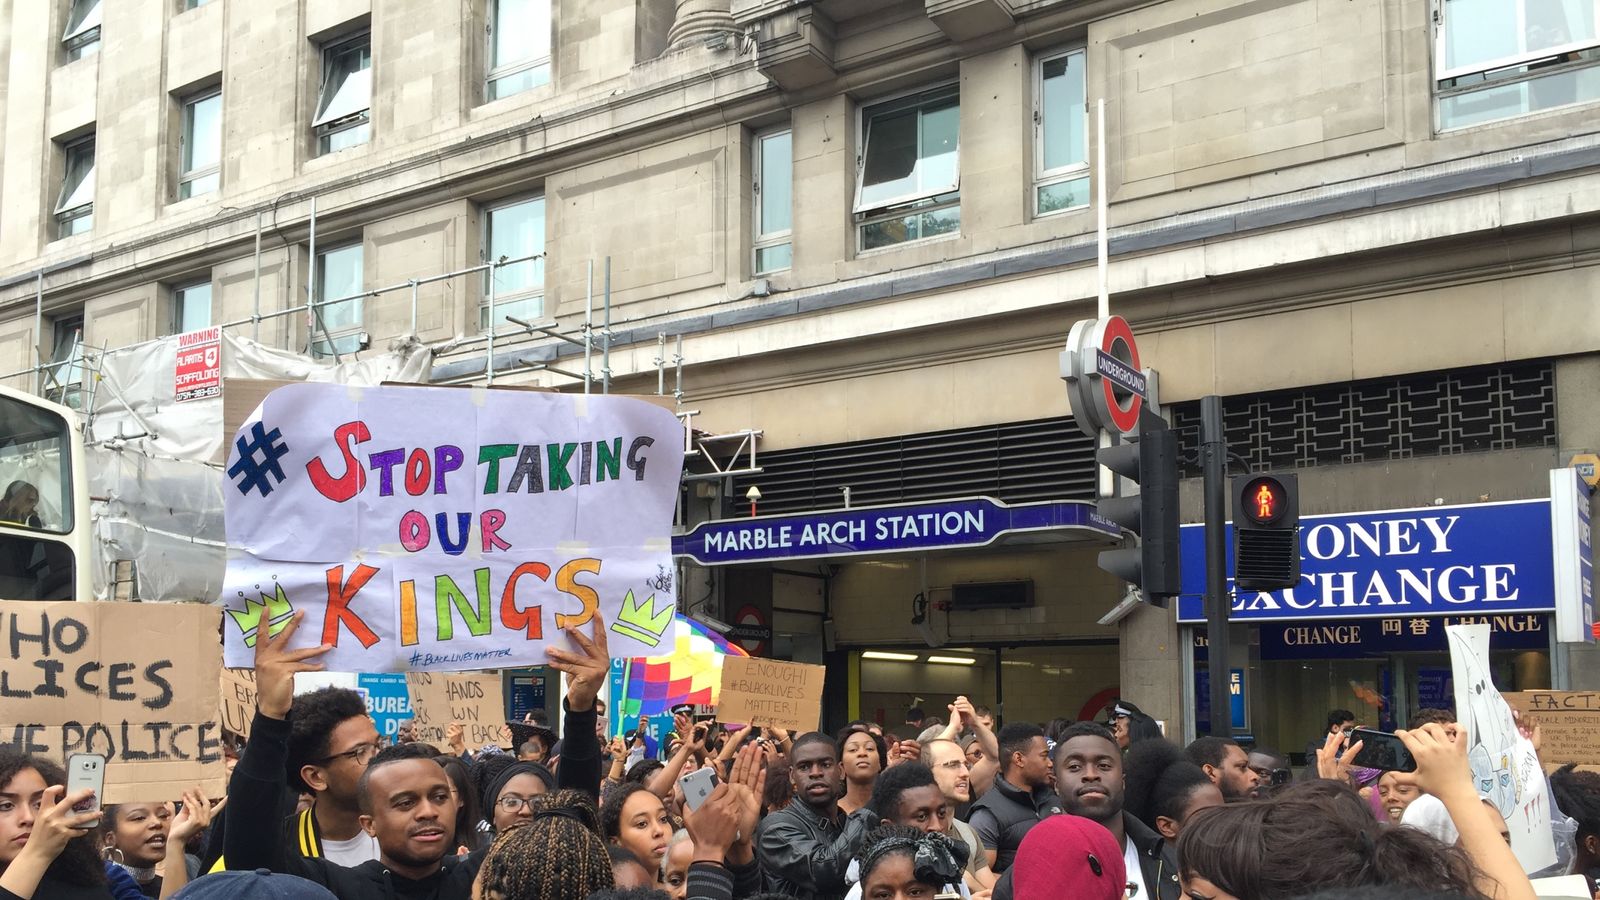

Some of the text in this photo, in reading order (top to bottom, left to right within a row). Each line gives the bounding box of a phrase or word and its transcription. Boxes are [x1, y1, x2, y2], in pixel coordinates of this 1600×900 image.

[179, 328, 219, 347] WARNING
[177, 351, 215, 367] ALARMS 4
[176, 368, 219, 385] SCAFFOLDING
[1097, 355, 1145, 392] UNDERGROUND
[478, 436, 654, 495] TAKING
[400, 509, 512, 555] OUR
[704, 510, 985, 554] MARBLE ARCH STATION
[1296, 515, 1460, 562] ONEY
[321, 558, 602, 649] KINGS
[0, 609, 90, 660] HO
[1284, 625, 1361, 646] CHANGE
[745, 663, 807, 685] ENOUGH!
[235, 682, 258, 707] BR
[731, 679, 805, 700] #BLACKLIVES
[1529, 694, 1600, 709] FACT
[62, 719, 222, 764] POLICE
[472, 724, 507, 744] BACK
